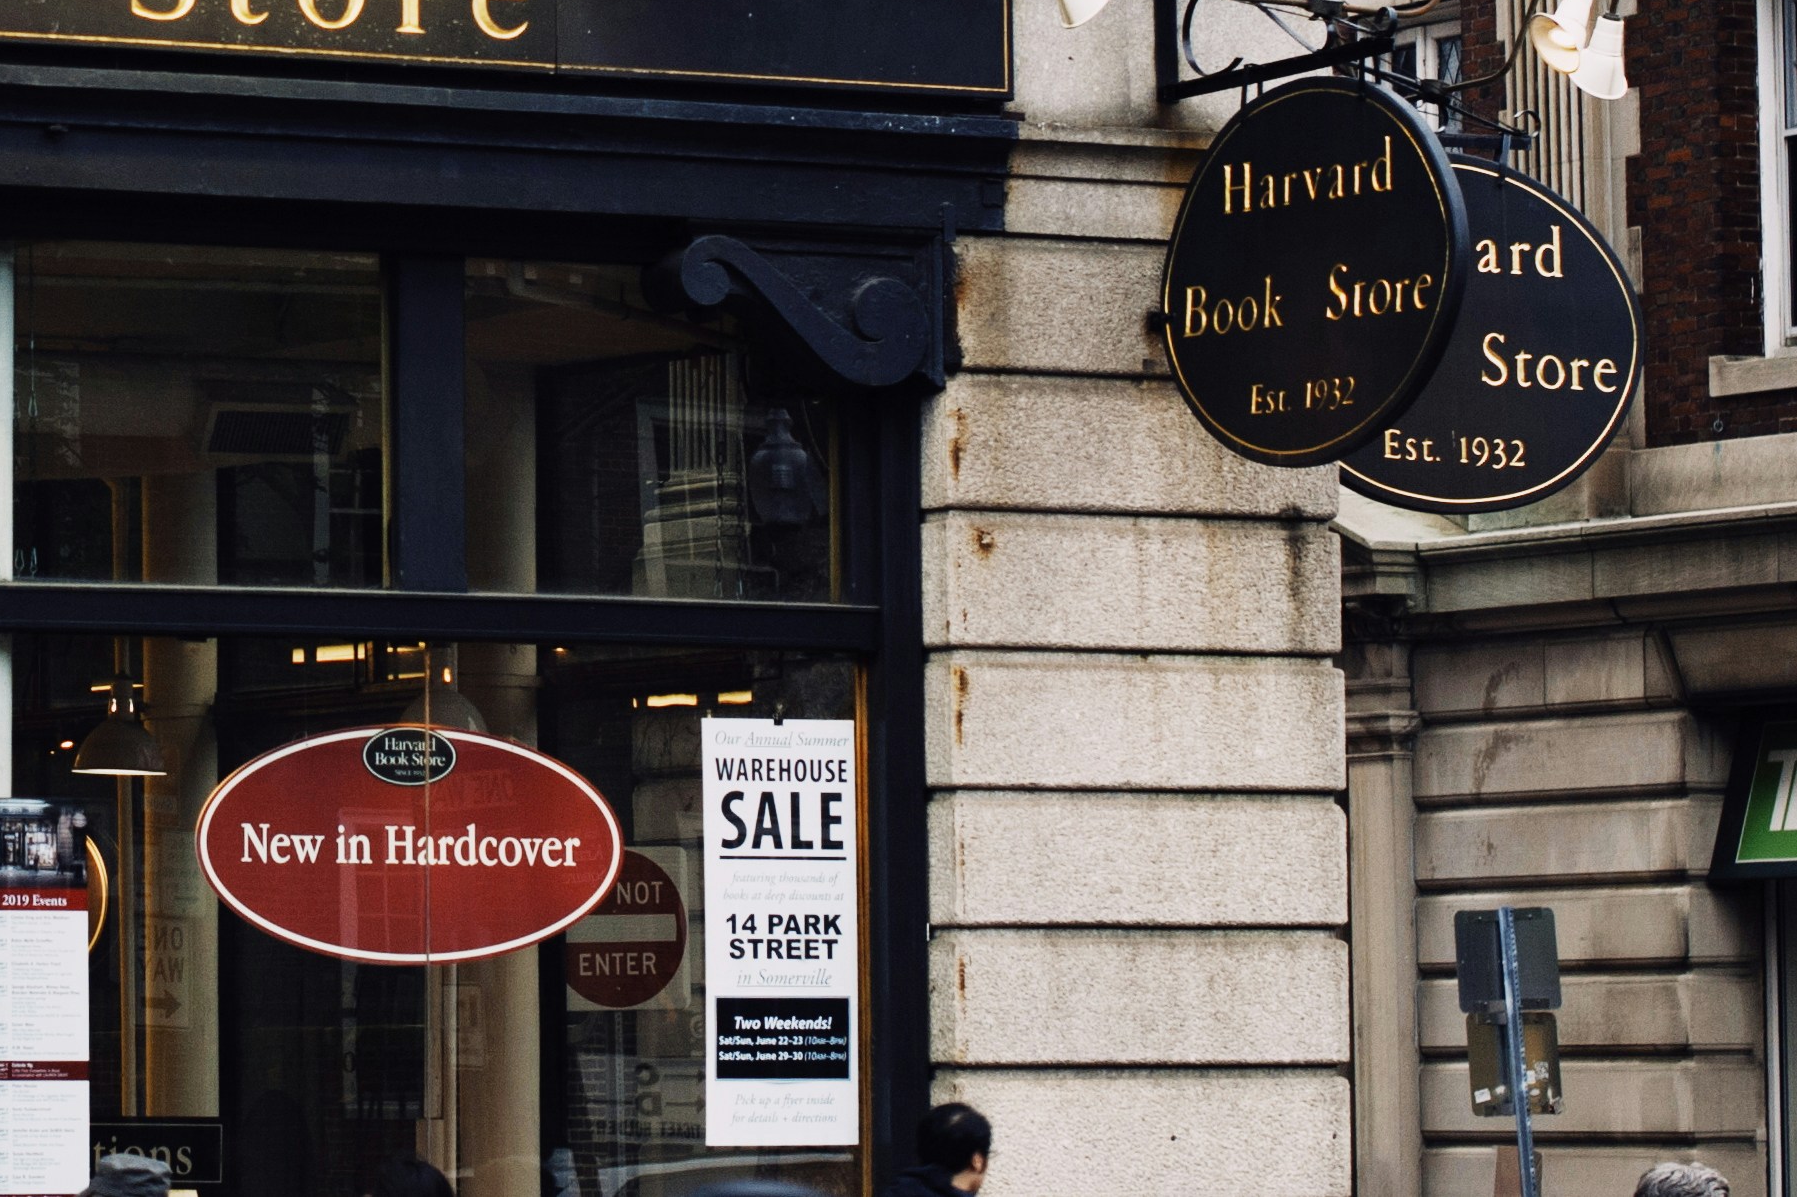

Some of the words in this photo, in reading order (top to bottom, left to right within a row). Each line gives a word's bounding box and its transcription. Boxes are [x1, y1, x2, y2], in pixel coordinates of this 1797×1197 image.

[1223, 135, 1394, 215] Harvard
[1183, 274, 1283, 338] Book
[1325, 263, 1433, 321] Store
[1481, 332, 1618, 393] Store
[1250, 383, 1291, 415] Est.
[1304, 376, 1355, 411] 1932
[1384, 428, 1441, 462] Est.
[1460, 436, 1526, 470] 1932
[715, 730, 741, 746] Our
[745, 731, 793, 747] Annual
[796, 733, 849, 747] Summer
[375, 751, 409, 765] Book
[411, 752, 446, 767] Store
[715, 757, 847, 782] WAREHOUSE
[721, 790, 844, 849] SALE
[240, 823, 325, 864] New
[336, 824, 373, 865] in
[385, 823, 581, 867] Hardcover
[731, 871, 776, 885] featuring
[779, 871, 825, 883] thousands
[828, 872, 840, 885] of
[2, 894, 30, 906] 2019
[32, 894, 67, 906] Events
[617, 881, 663, 904] NOT
[723, 888, 749, 901] books
[751, 892, 762, 901] at
[764, 889, 785, 903] deep
[789, 889, 831, 901] discounts
[834, 892, 844, 901] at
[726, 914, 757, 934] 14
[768, 914, 842, 935] PARK
[729, 938, 838, 959] STREET
[579, 952, 657, 976] ENTER
[737, 973, 752, 986] in
[756, 968, 832, 986] Somerville
[734, 1016, 761, 1030] Two
[763, 1016, 833, 1030] Weekends!
[755, 1036, 777, 1046] June
[755, 1051, 777, 1061] June
[735, 1093, 756, 1105] Pick
[758, 1097, 772, 1109] up
[806, 1093, 835, 1105] inside
[731, 1112, 745, 1125] for
[747, 1111, 778, 1123] details
[792, 1111, 837, 1123] directions
